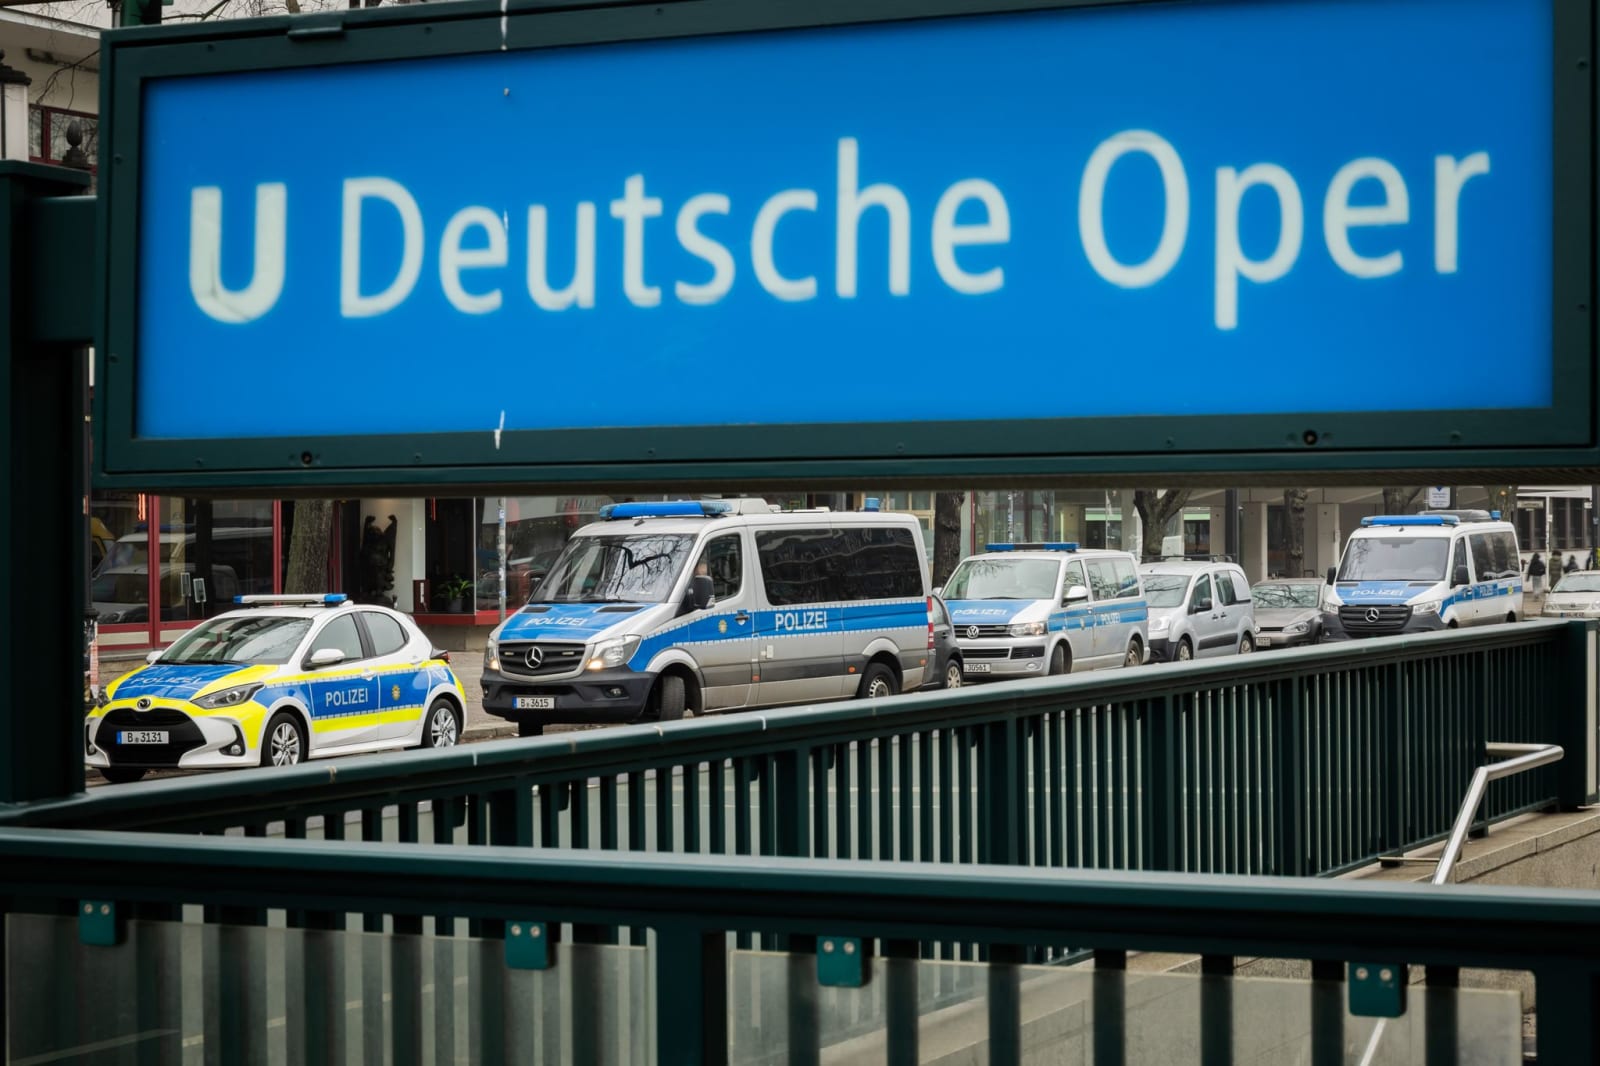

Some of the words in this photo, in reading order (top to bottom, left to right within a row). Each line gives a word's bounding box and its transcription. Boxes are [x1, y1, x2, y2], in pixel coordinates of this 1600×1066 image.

[189, 182, 288, 325] U
[340, 137, 1010, 318] Deutsche
[1077, 129, 1491, 331] Oper
[1351, 588, 1404, 597] POLIZEI
[952, 608, 1008, 616] POLIZEI
[524, 617, 588, 626] POLIZEI
[775, 610, 828, 632] POLIZEI
[325, 687, 369, 707] POLIZEI
